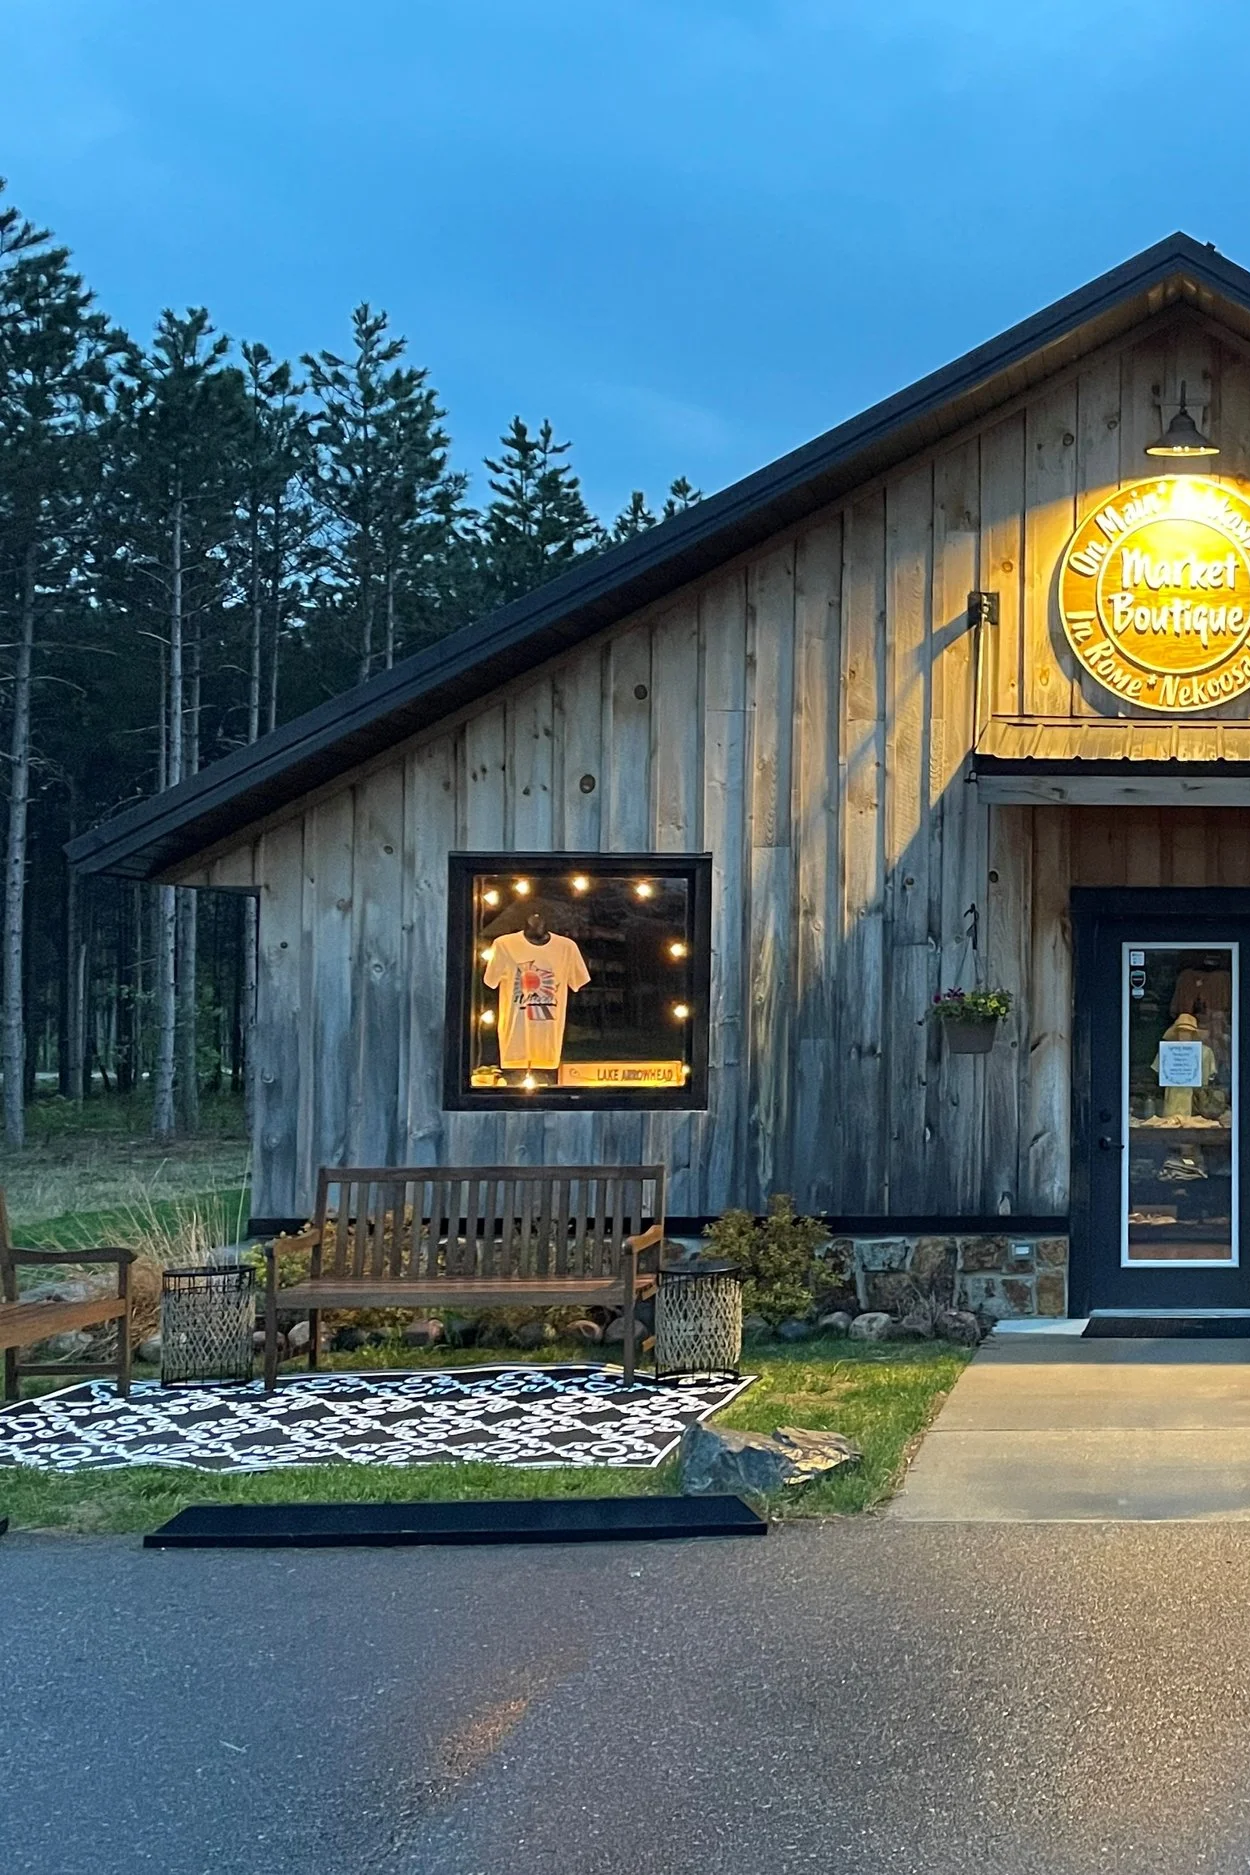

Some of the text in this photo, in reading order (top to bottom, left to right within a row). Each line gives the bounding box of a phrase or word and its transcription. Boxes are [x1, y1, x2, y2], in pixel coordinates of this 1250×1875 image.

[1068, 541, 1107, 576] On
[1095, 489, 1160, 543] Main
[1121, 547, 1240, 590] Market
[1066, 611, 1097, 642] In
[1108, 592, 1245, 648] Boutique
[597, 1068, 673, 1082] LAKE ARROWHEAD
